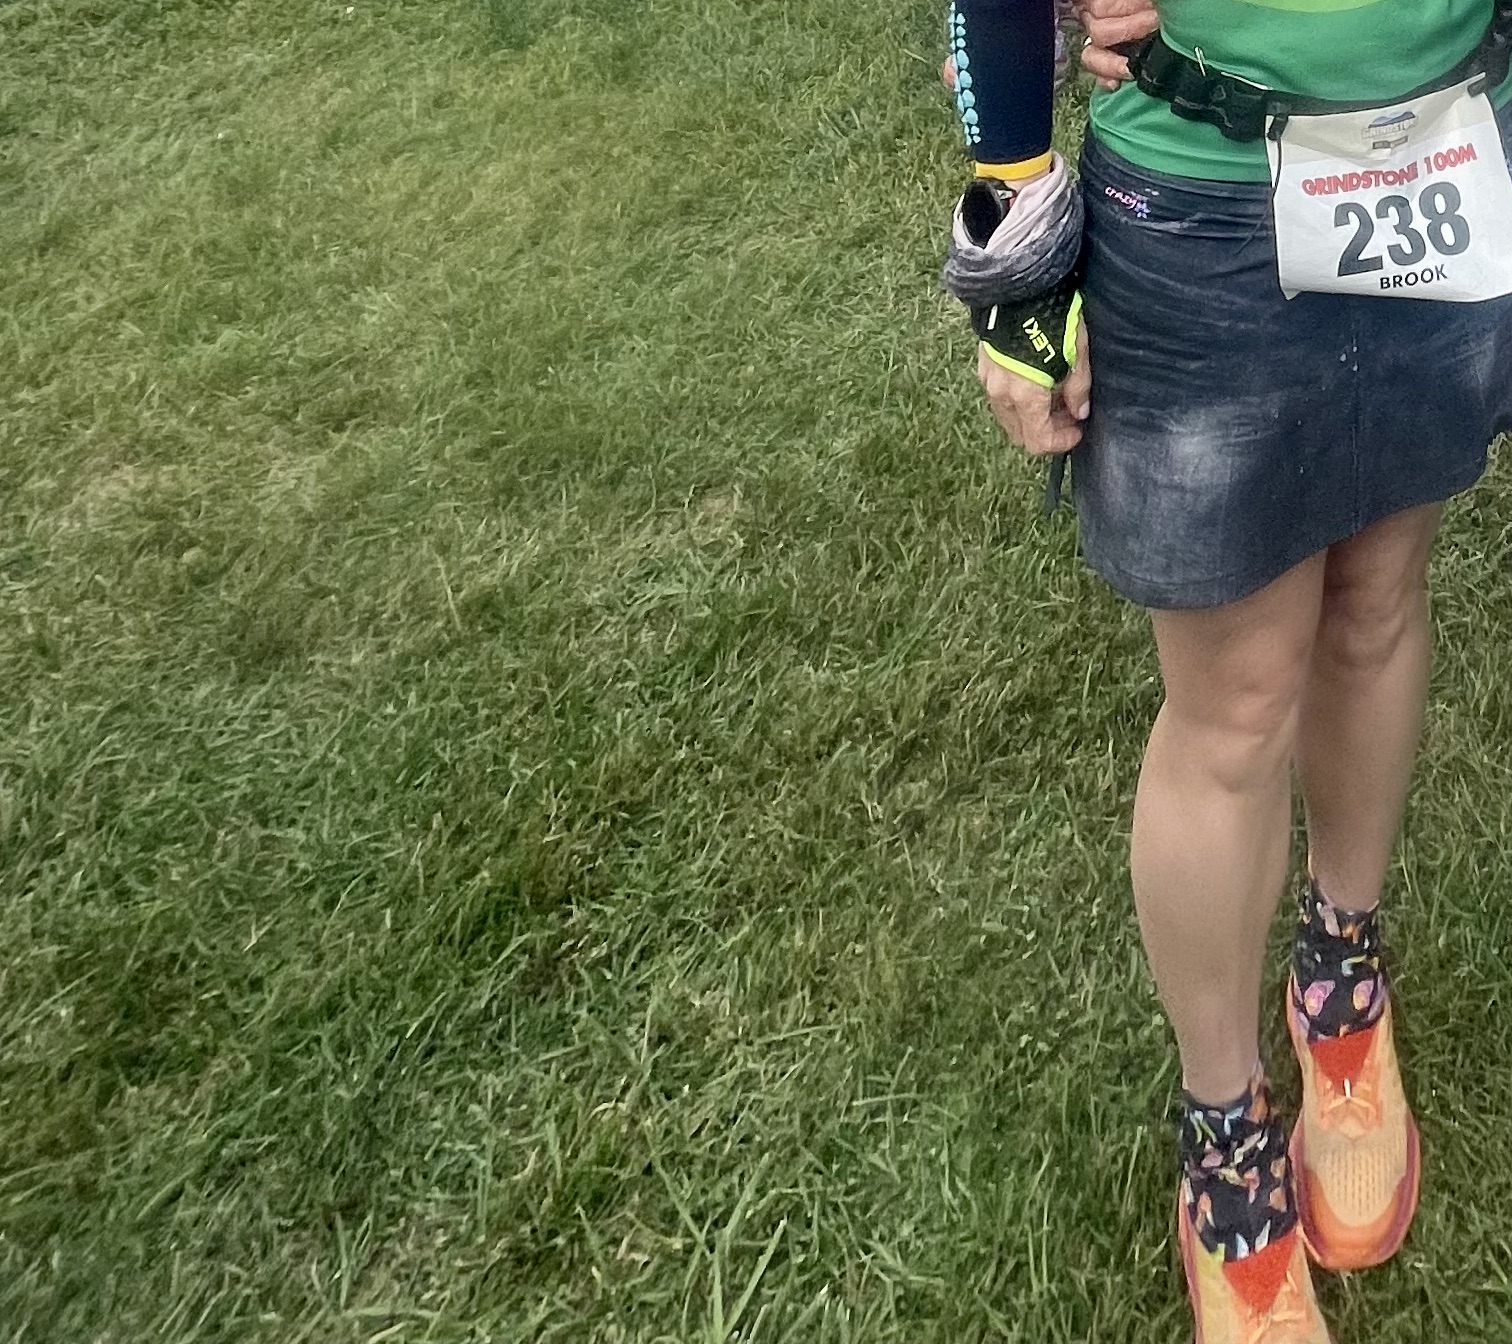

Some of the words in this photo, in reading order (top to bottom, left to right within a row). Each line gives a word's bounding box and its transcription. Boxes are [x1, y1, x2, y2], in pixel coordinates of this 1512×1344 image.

[1301, 160, 1419, 196] GRINDSTONE
[1424, 143, 1478, 175] 100M
[1333, 181, 1471, 278] 238
[1380, 263, 1448, 290] BROOK
[1022, 316, 1056, 364] LEKI
